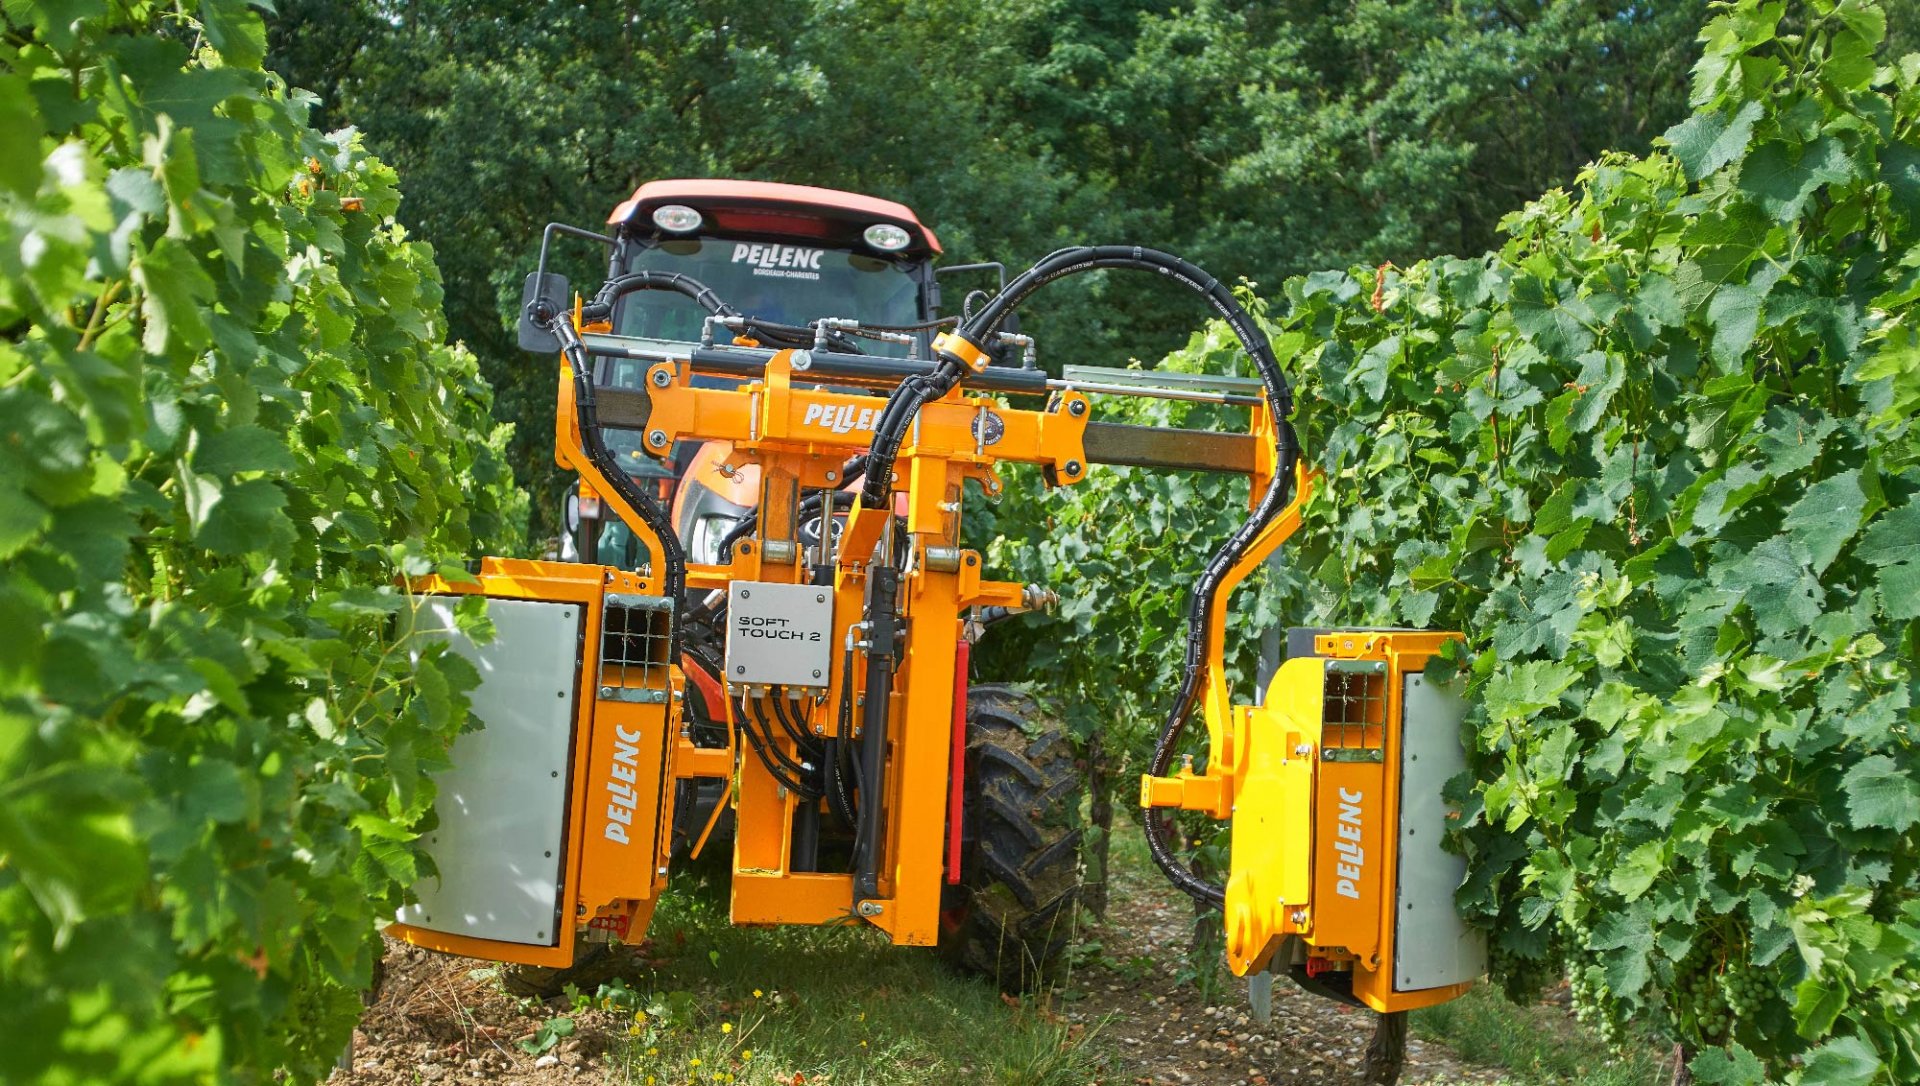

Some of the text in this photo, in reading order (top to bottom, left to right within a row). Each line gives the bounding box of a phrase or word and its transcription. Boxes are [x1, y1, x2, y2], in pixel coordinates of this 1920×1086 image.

[731, 243, 825, 270] PELLENC
[803, 403, 884, 434] PELLE
[738, 616, 790, 627] SOFT
[738, 628, 821, 642] TOUCH 2
[605, 724, 641, 845] PELLENC
[1334, 787, 1364, 899] PELLENC
